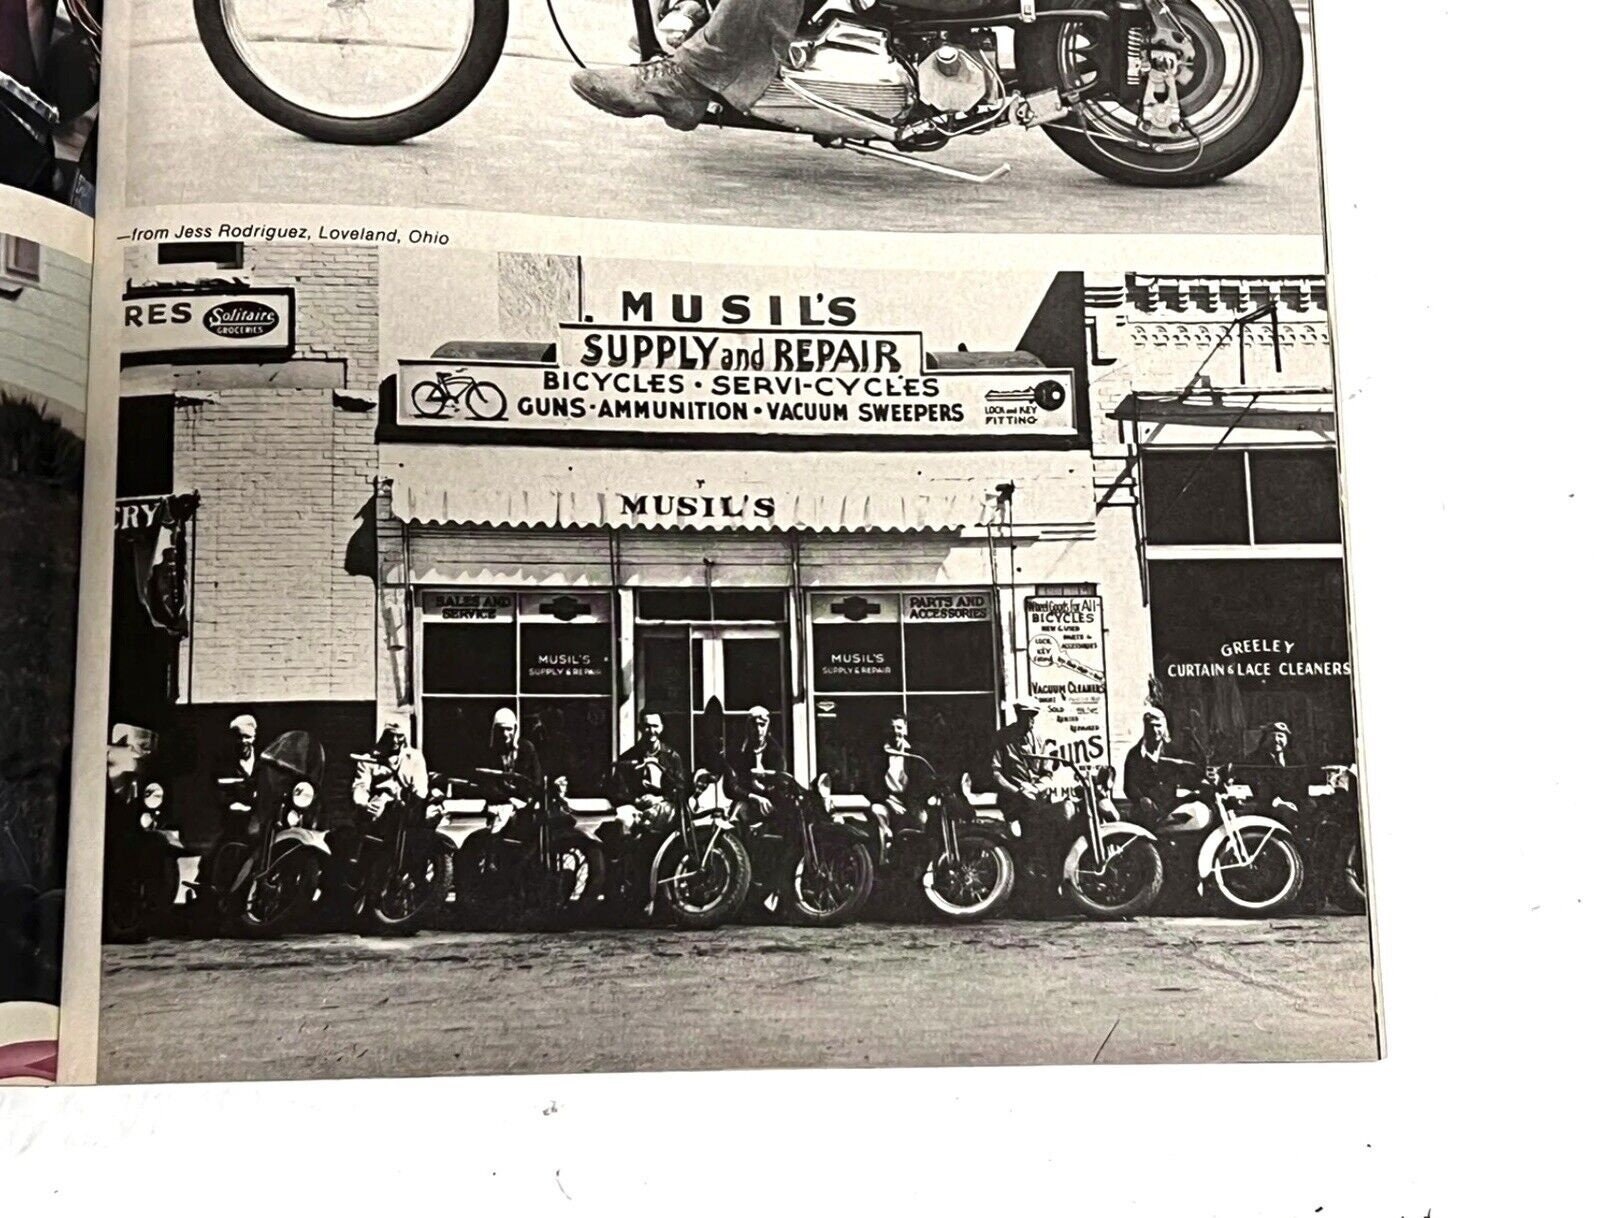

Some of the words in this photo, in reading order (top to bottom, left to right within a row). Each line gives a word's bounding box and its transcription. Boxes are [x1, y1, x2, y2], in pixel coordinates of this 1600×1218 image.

[175, 225, 212, 239] Jess
[218, 224, 311, 241] Rodriguez,
[318, 226, 401, 244] Loveland,
[409, 229, 450, 245] Ohio
[125, 302, 192, 328] RES
[622, 290, 857, 327] MUSIL'S
[208, 307, 275, 328] Solitaire
[217, 326, 264, 335] GROCERIES
[580, 333, 719, 369] SUPPLY
[720, 337, 763, 371] and
[774, 338, 901, 373] REPAIR
[543, 371, 685, 395] BICYCLES
[711, 375, 940, 397] SERVI-CYCLES
[598, 399, 748, 421] AMMUNITION
[767, 401, 848, 422] VACUUM
[858, 402, 965, 423] SWEEPERS
[1019, 405, 1038, 415] KEY
[985, 415, 1038, 425] FITTING
[619, 494, 776, 518] MUSIL'S
[436, 595, 480, 608] SALES
[482, 595, 513, 609] AND
[909, 596, 953, 608] PARTS
[956, 596, 986, 608] AND
[442, 607, 498, 620] SERVICE
[909, 608, 988, 620] ACCESSORIES
[1032, 613, 1094, 623] BICYCLES
[1220, 639, 1295, 657] GREELEY
[538, 654, 591, 665] MUSIL'S
[831, 653, 885, 664] MUSIL'S
[528, 668, 563, 676] SUPPLY
[822, 666, 853, 675] SUPPLY
[861, 666, 892, 675] REPAIR
[1167, 663, 1226, 677] CURTAIN
[1237, 663, 1271, 676] LACE
[1278, 662, 1351, 676] CLEANERS
[1032, 682, 1066, 694] VACUUM
[1068, 681, 1105, 694] CLEANERS
